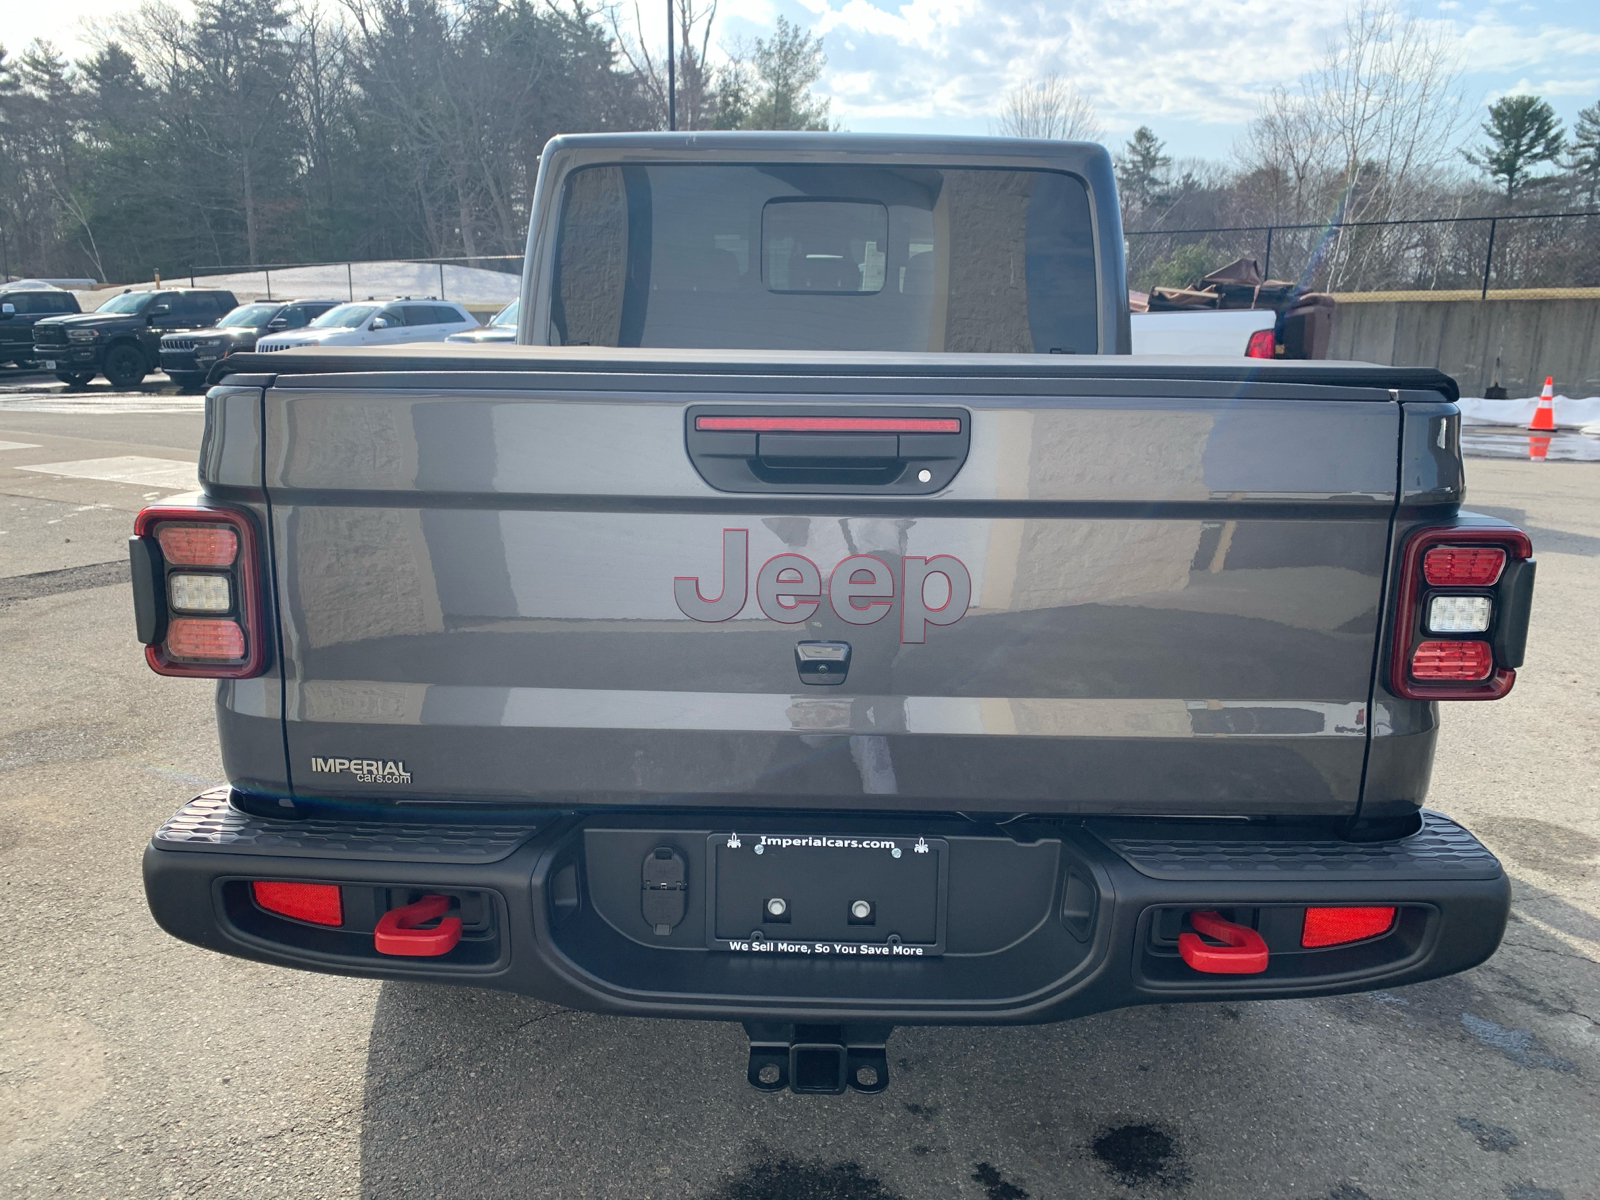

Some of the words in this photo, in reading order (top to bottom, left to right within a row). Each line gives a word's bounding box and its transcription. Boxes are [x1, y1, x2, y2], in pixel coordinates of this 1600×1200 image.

[673, 527, 972, 644] Jeep
[311, 757, 411, 776] IMPERIAL
[356, 773, 411, 784] cars.com
[760, 835, 895, 849] Imperialcars.com
[729, 941, 748, 951] We
[751, 942, 774, 952] Sell
[777, 942, 811, 954] More,
[814, 944, 830, 954] So
[834, 944, 857, 954] You
[860, 945, 889, 955] Save
[893, 945, 923, 956] More
